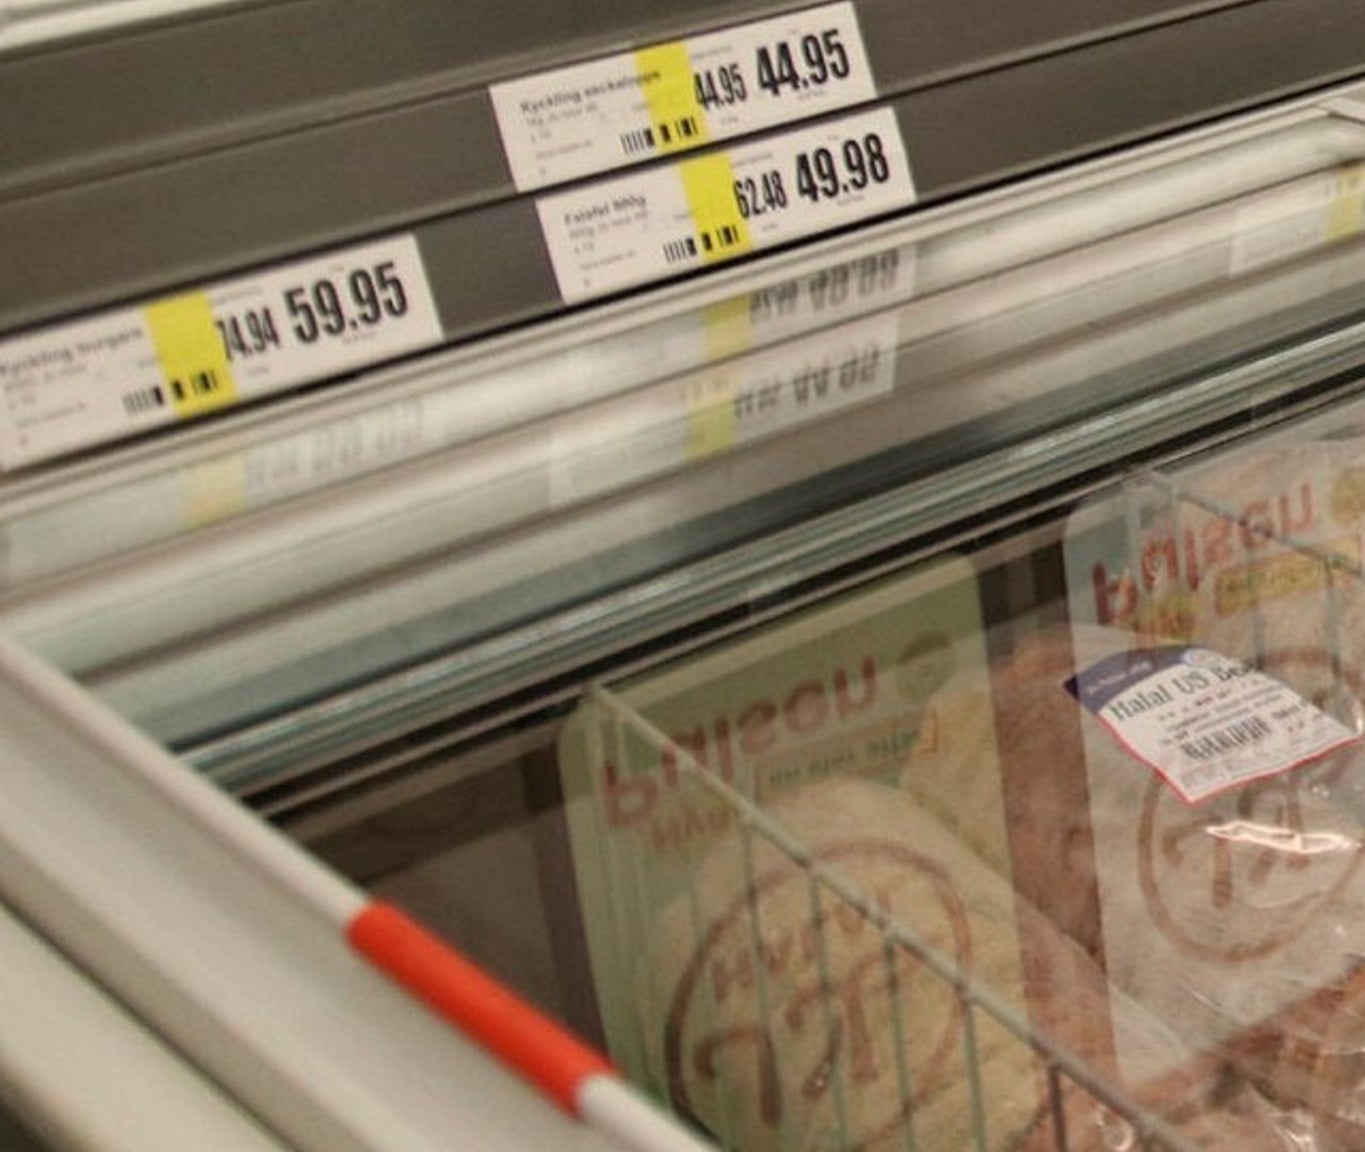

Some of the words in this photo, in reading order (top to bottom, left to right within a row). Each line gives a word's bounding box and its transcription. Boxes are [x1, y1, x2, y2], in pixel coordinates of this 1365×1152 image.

[694, 63, 749, 113] 44.95
[755, 28, 852, 98] 44.95
[731, 170, 788, 221] 62.48
[795, 132, 891, 204] 49.98
[214, 305, 281, 362] 74.94
[283, 260, 410, 346] 59.95
[1107, 684, 1173, 722] Halal
[1172, 667, 1210, 696] US
